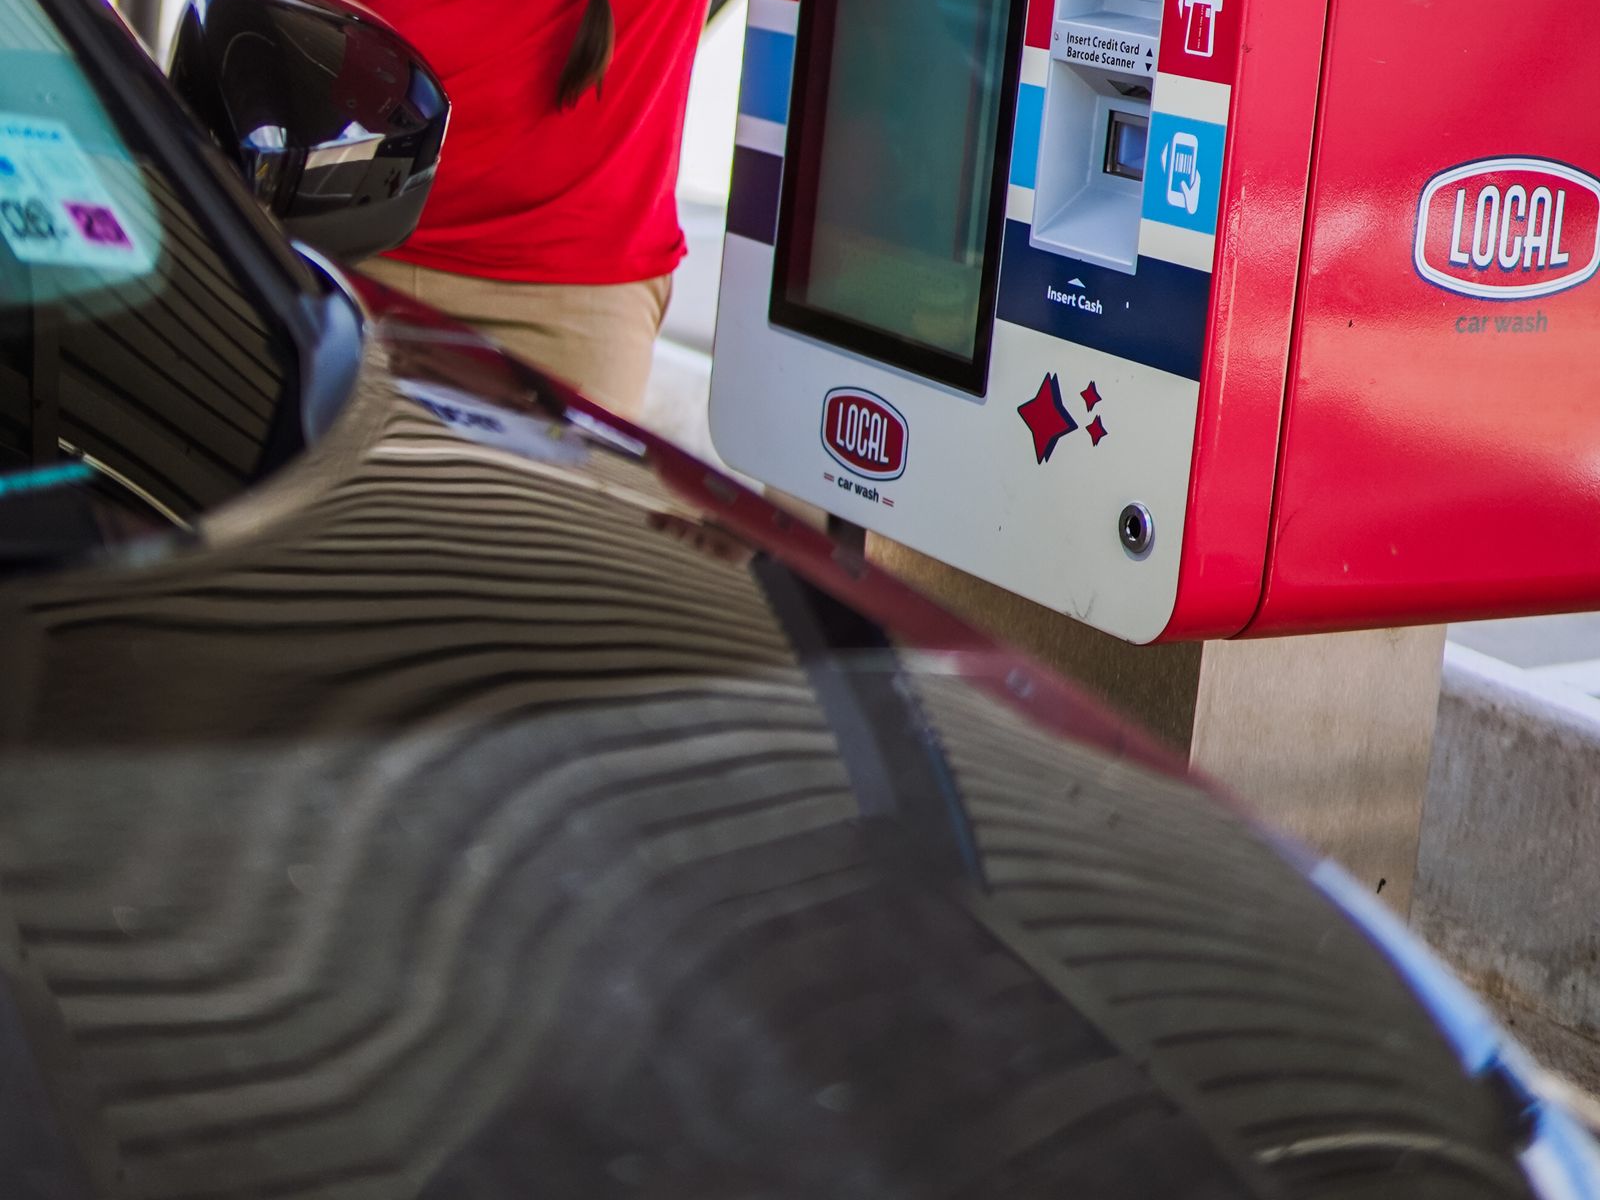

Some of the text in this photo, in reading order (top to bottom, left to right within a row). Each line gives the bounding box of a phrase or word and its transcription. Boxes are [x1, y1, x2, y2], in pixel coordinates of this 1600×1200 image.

[1066, 32, 1140, 55] Insert Credit Card
[1066, 46, 1136, 69] Barcode Scanner
[1449, 184, 1570, 272] LOCAL
[1047, 285, 1103, 314] Insert Cash
[1455, 310, 1549, 333] car wash
[836, 402, 889, 463] LOCAL
[837, 477, 880, 503] car wash
